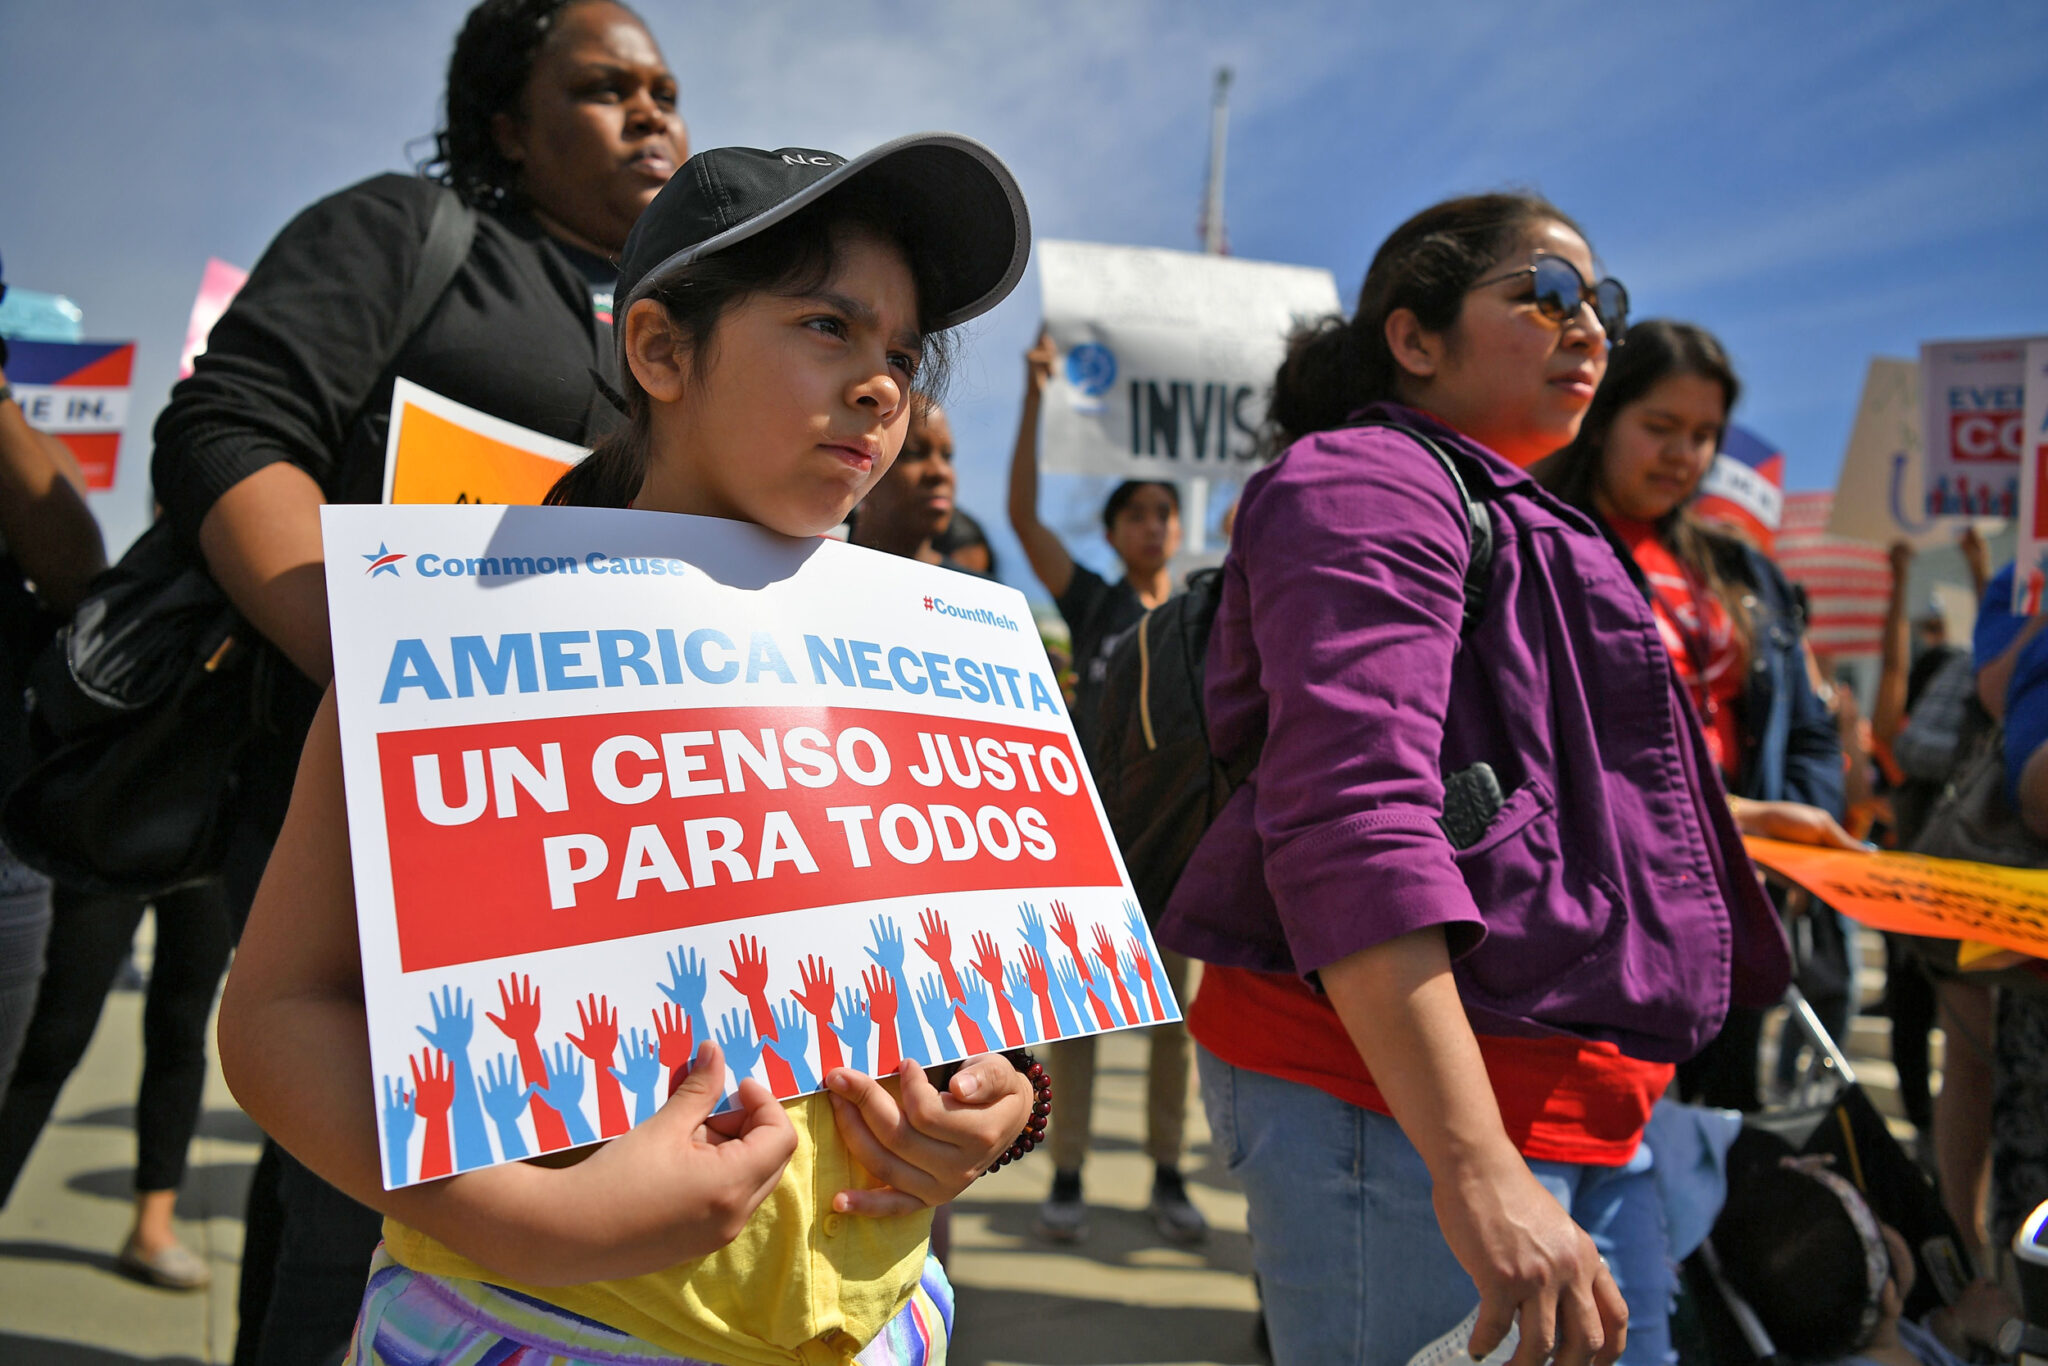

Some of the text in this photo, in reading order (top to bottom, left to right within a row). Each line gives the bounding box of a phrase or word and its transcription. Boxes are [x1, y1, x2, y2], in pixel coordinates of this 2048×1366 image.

[781, 154, 846, 167] NC
[416, 551, 685, 577] Common Cause
[923, 595, 1019, 632] #CountMeIn
[379, 628, 1060, 715] AMERICA NECESITA
[412, 727, 1079, 826] UN CENSO JUSTO
[543, 803, 1057, 910] PARA TODOS
